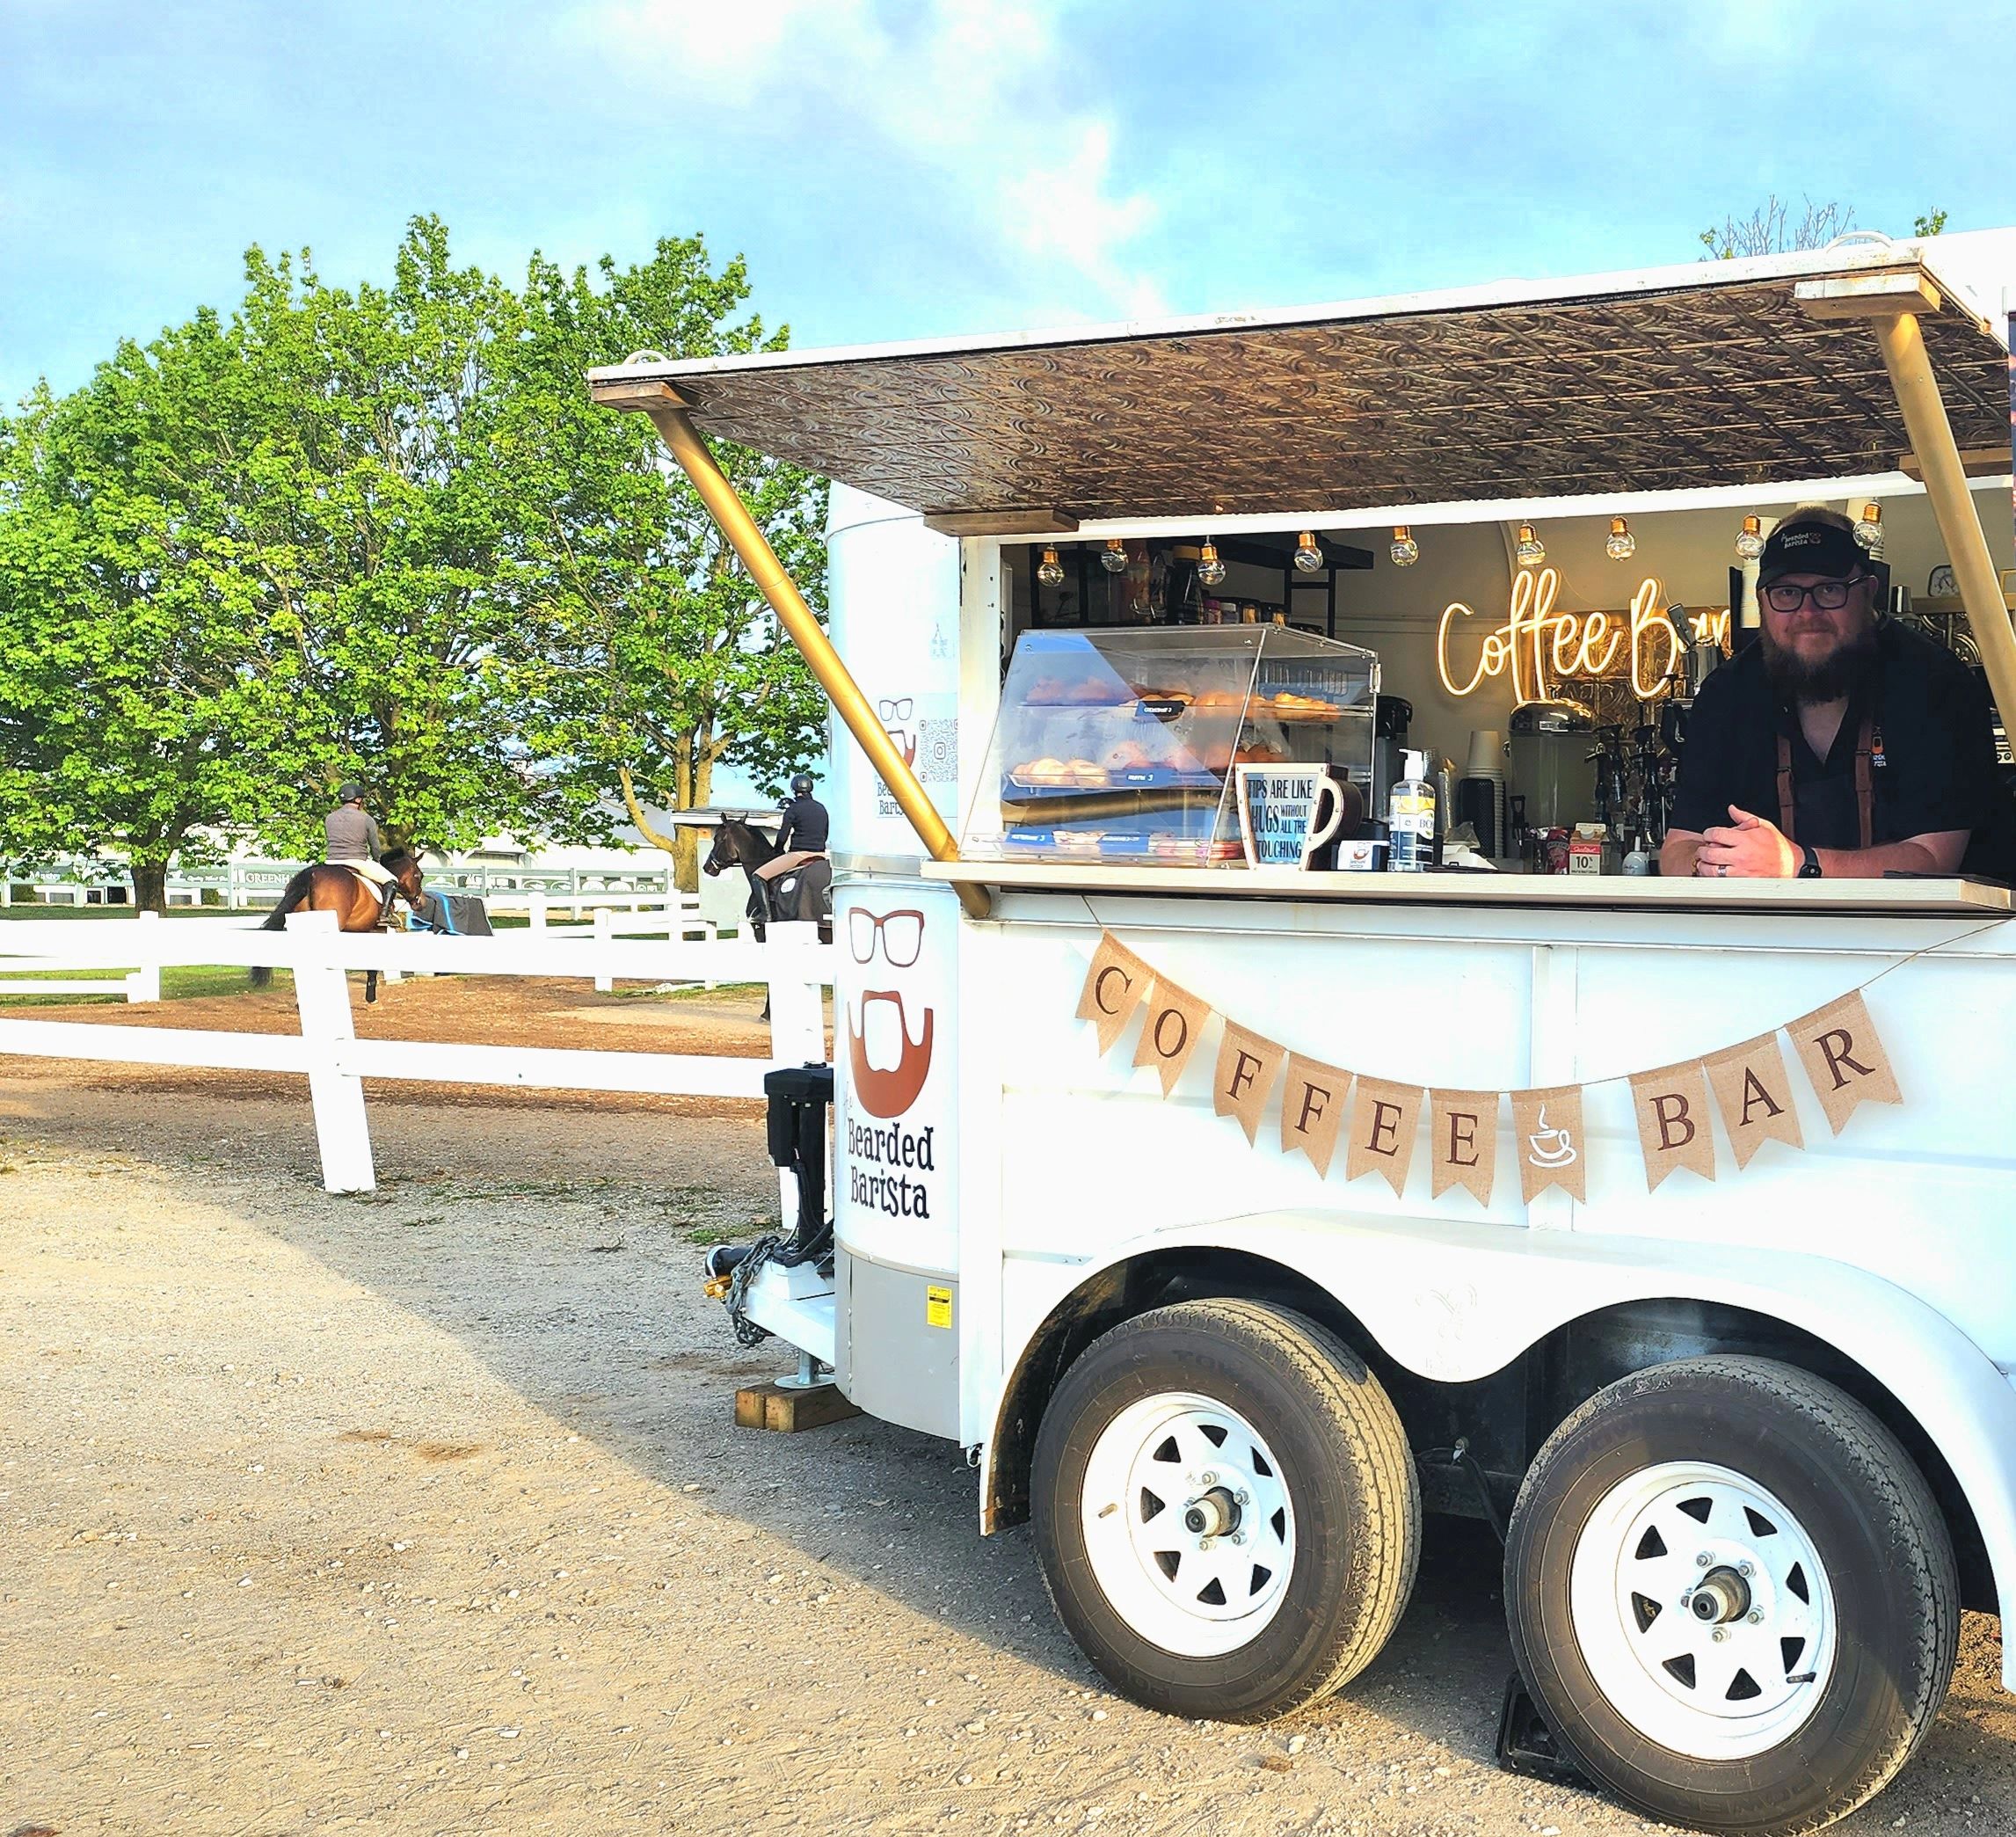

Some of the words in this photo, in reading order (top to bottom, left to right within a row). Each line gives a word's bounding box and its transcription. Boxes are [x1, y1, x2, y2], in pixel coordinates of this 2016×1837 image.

[1437, 567, 1624, 703] Coffee
[1247, 779, 1267, 799] TIPS
[1270, 779, 1289, 799] ARE
[1291, 779, 1313, 799] LIKE
[1251, 805, 1279, 835] HUGS
[1280, 805, 1307, 817] WITHOUT
[1281, 820, 1292, 834] ALL
[1293, 820, 1307, 835] THE
[1256, 840, 1301, 859] TOUCHING
[1095, 966, 1479, 1167] COFFEE
[1649, 1029, 1875, 1151] BAR
[848, 1117, 935, 1171] Bearded
[850, 1164, 930, 1220] Barista
